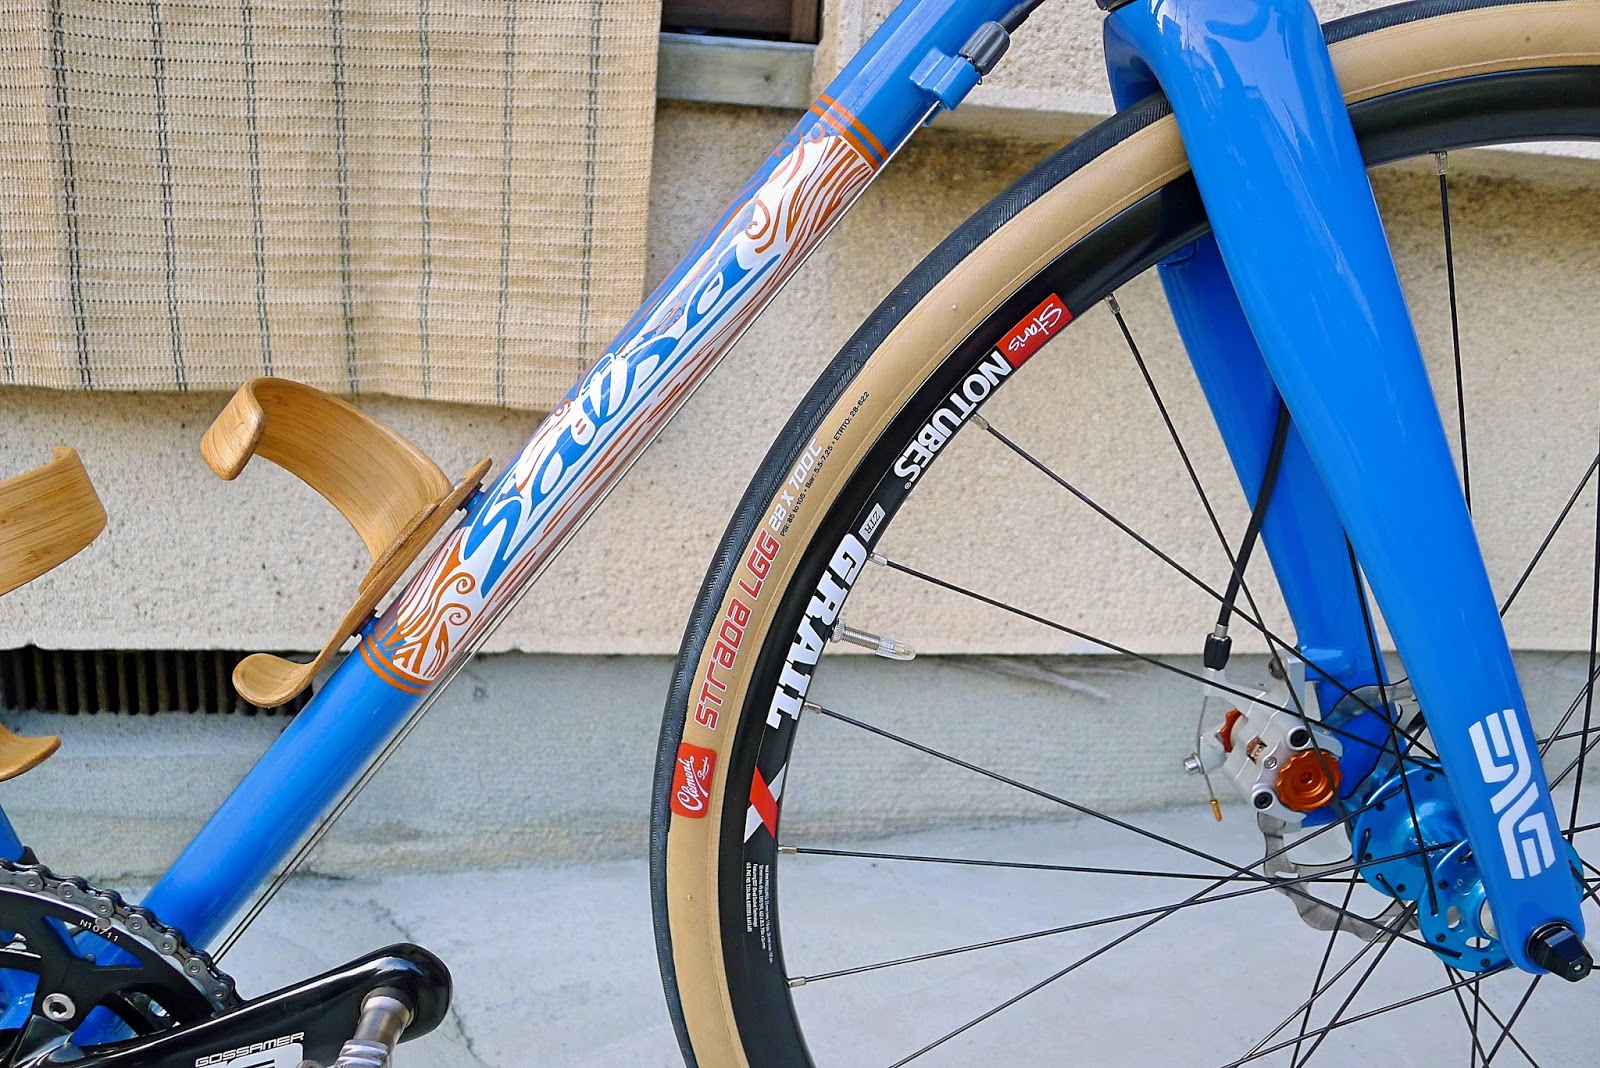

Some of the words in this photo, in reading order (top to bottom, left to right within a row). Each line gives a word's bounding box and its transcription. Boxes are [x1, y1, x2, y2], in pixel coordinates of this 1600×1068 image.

[1008, 302, 1063, 352] Stan's
[463, 242, 779, 599] Salsa
[796, 492, 806, 506] 105
[849, 391, 870, 417] 28-622
[768, 502, 787, 533] 28
[788, 437, 823, 491] 700C
[864, 510, 881, 535] ZTR
[738, 530, 782, 601] LGG
[766, 533, 868, 730] GRAIL
[195, 1031, 305, 1068] GOSSAMER
